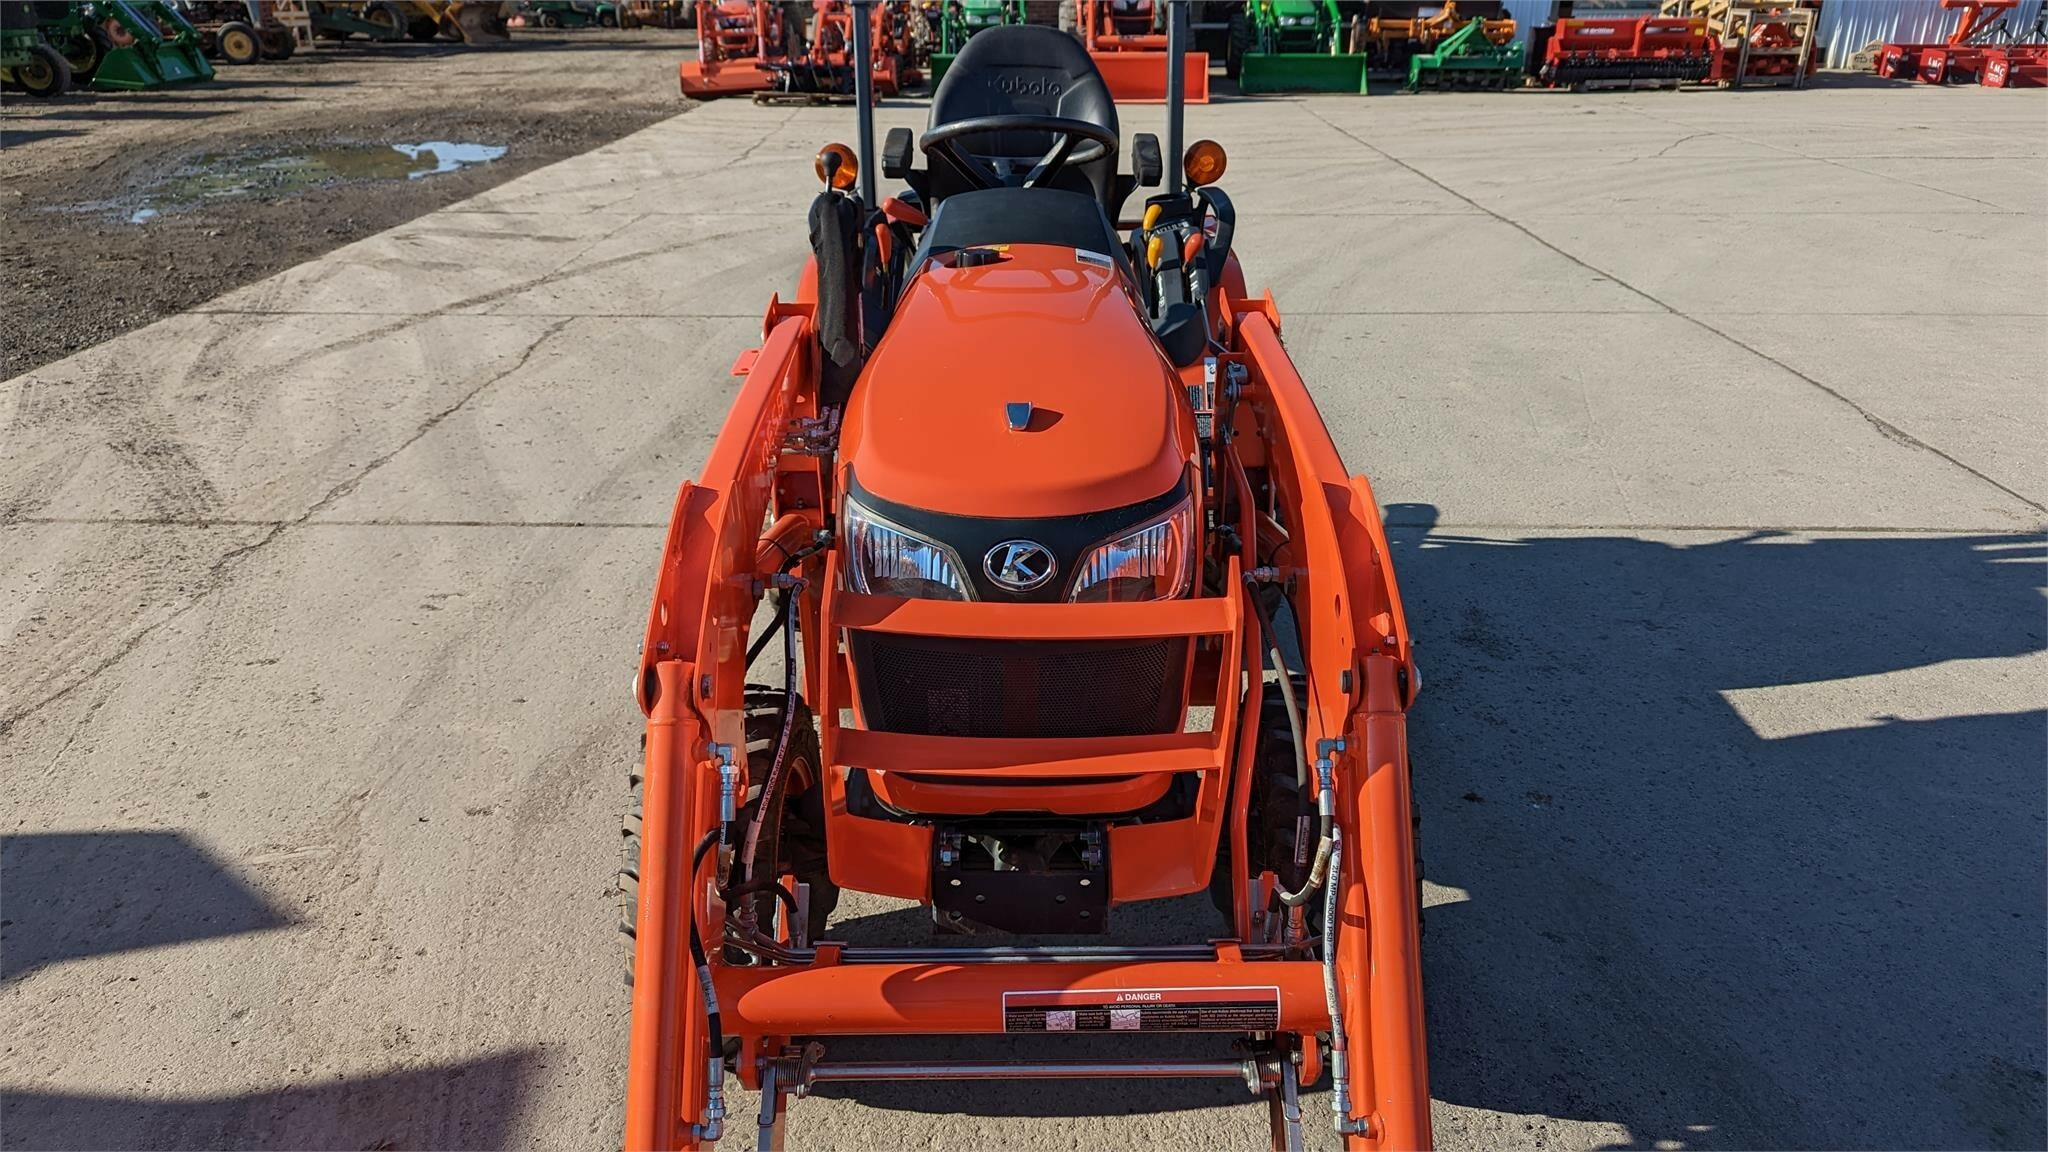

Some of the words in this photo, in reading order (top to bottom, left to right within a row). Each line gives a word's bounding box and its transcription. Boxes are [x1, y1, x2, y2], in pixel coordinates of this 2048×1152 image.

[1989, 60, 2005, 76] LMC
[987, 74, 1062, 97] Kubota
[1331, 864, 1339, 880] 21.0
[1125, 993, 1162, 1002] DANGER
